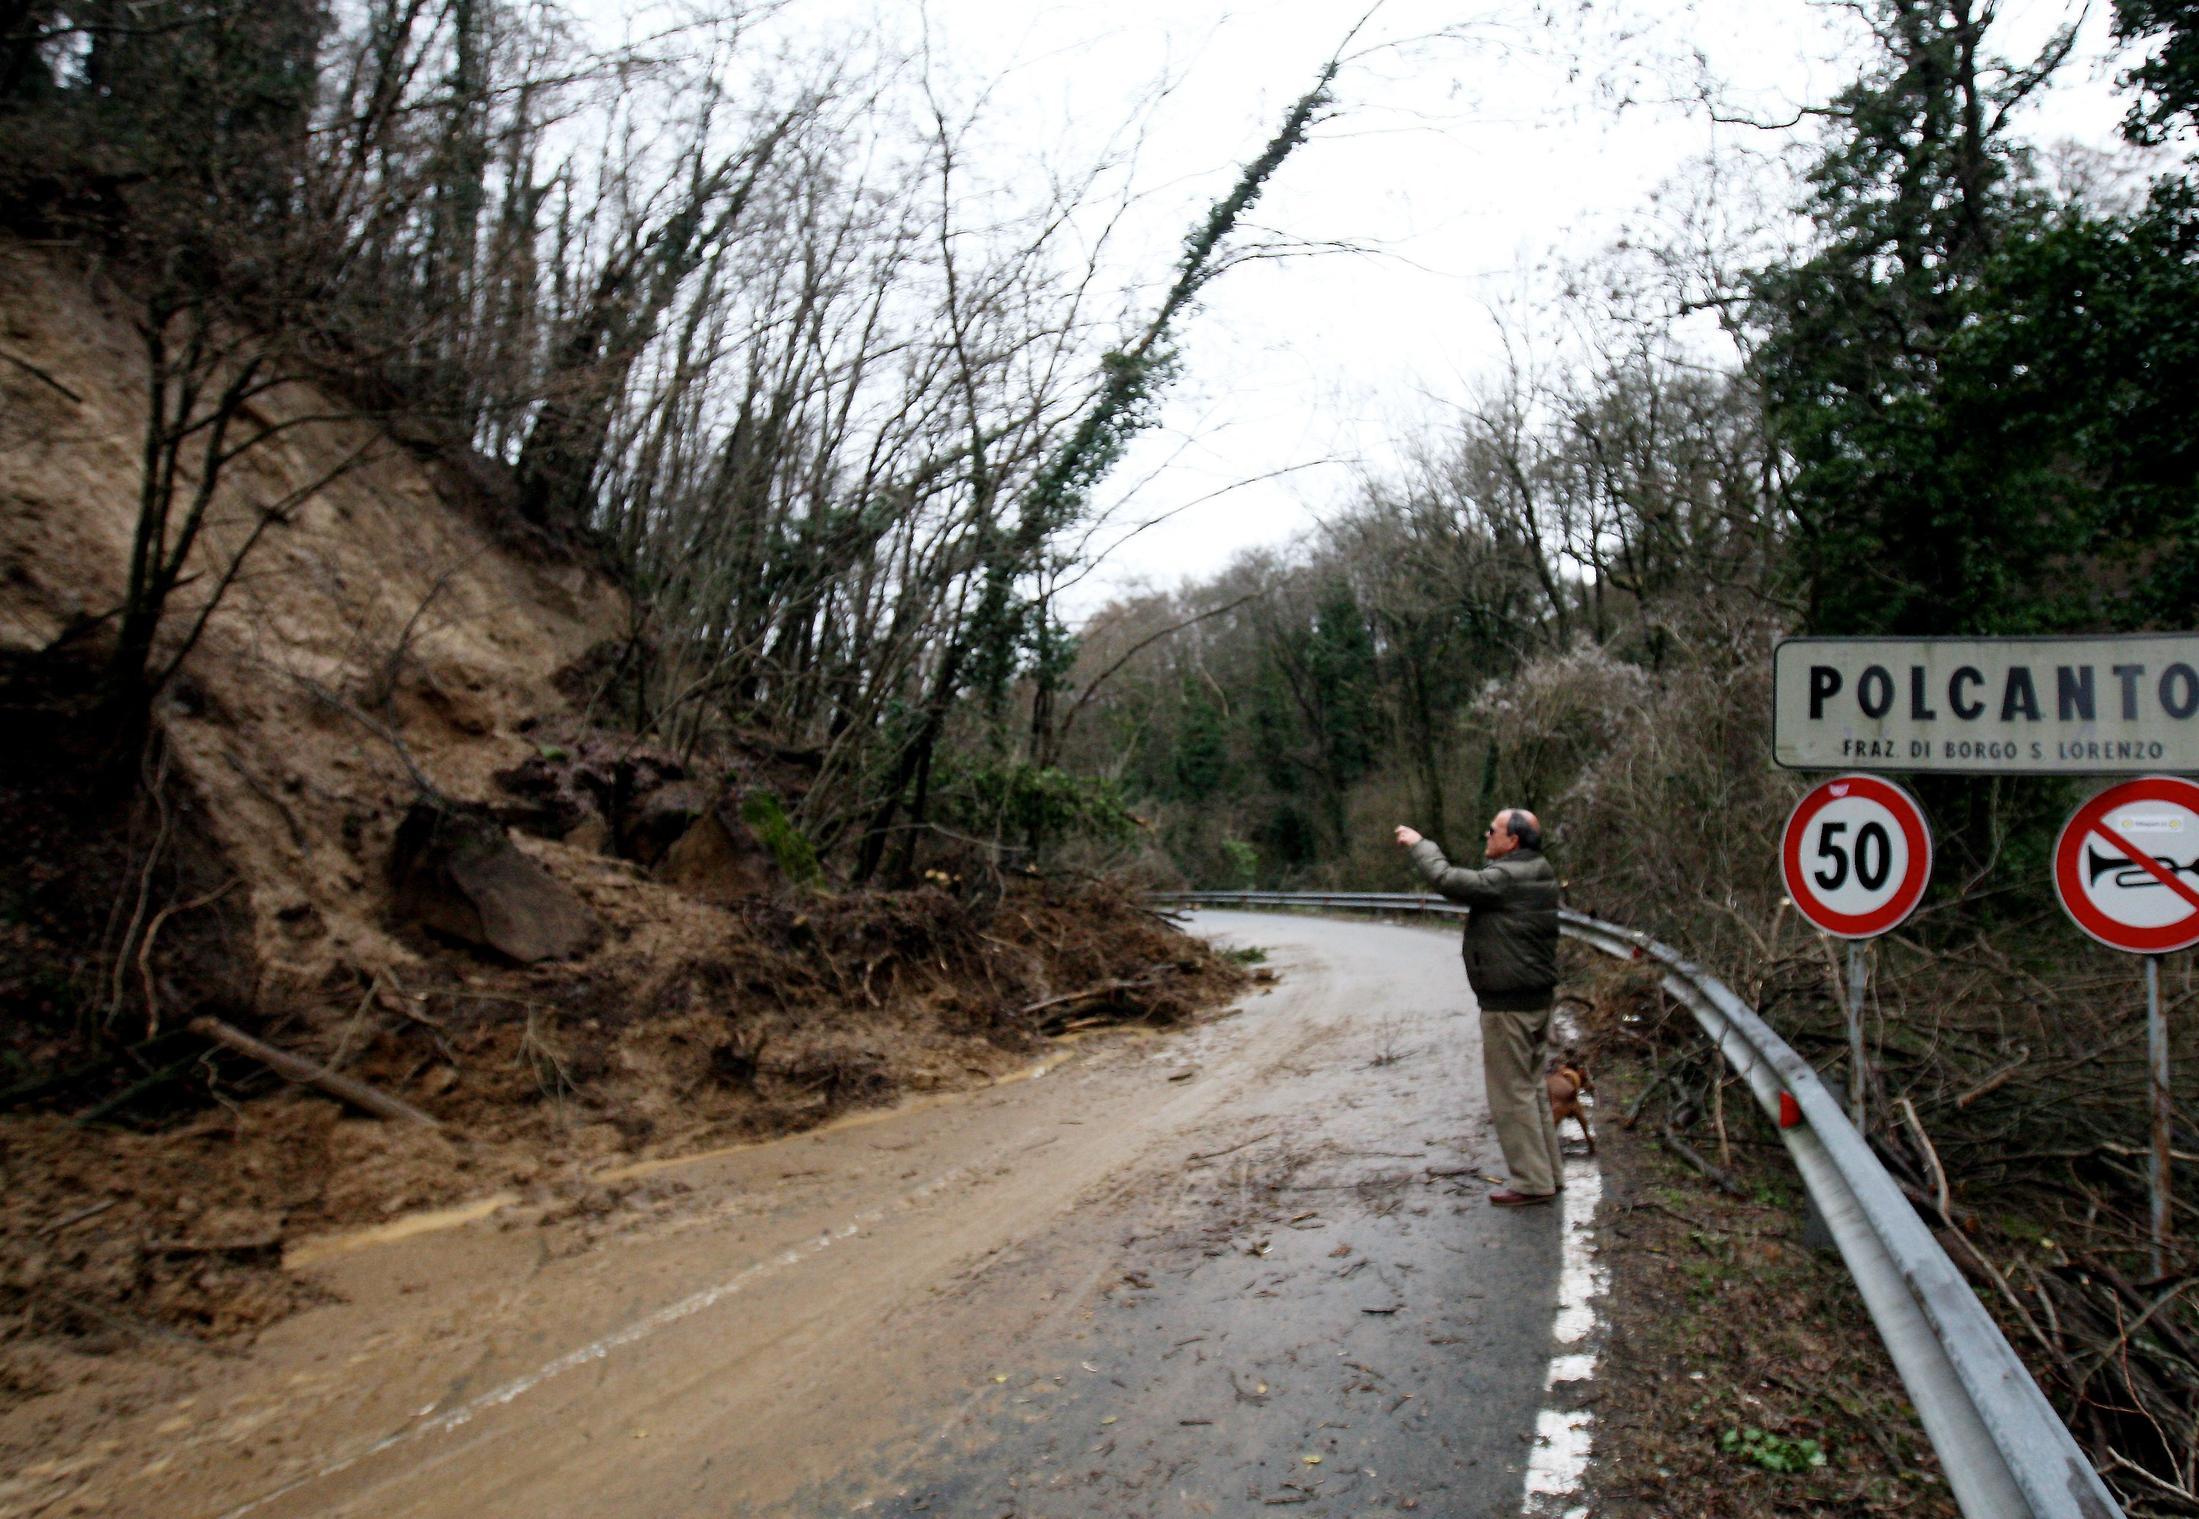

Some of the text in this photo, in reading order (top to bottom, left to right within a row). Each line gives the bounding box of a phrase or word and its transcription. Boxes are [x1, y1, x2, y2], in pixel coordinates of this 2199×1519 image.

[1809, 663, 2199, 721] POLCANTO
[1910, 740, 1931, 759] DI
[1945, 740, 2017, 759] BORGO
[2058, 740, 2163, 759] LORENZO
[1814, 821, 1892, 891] 50
